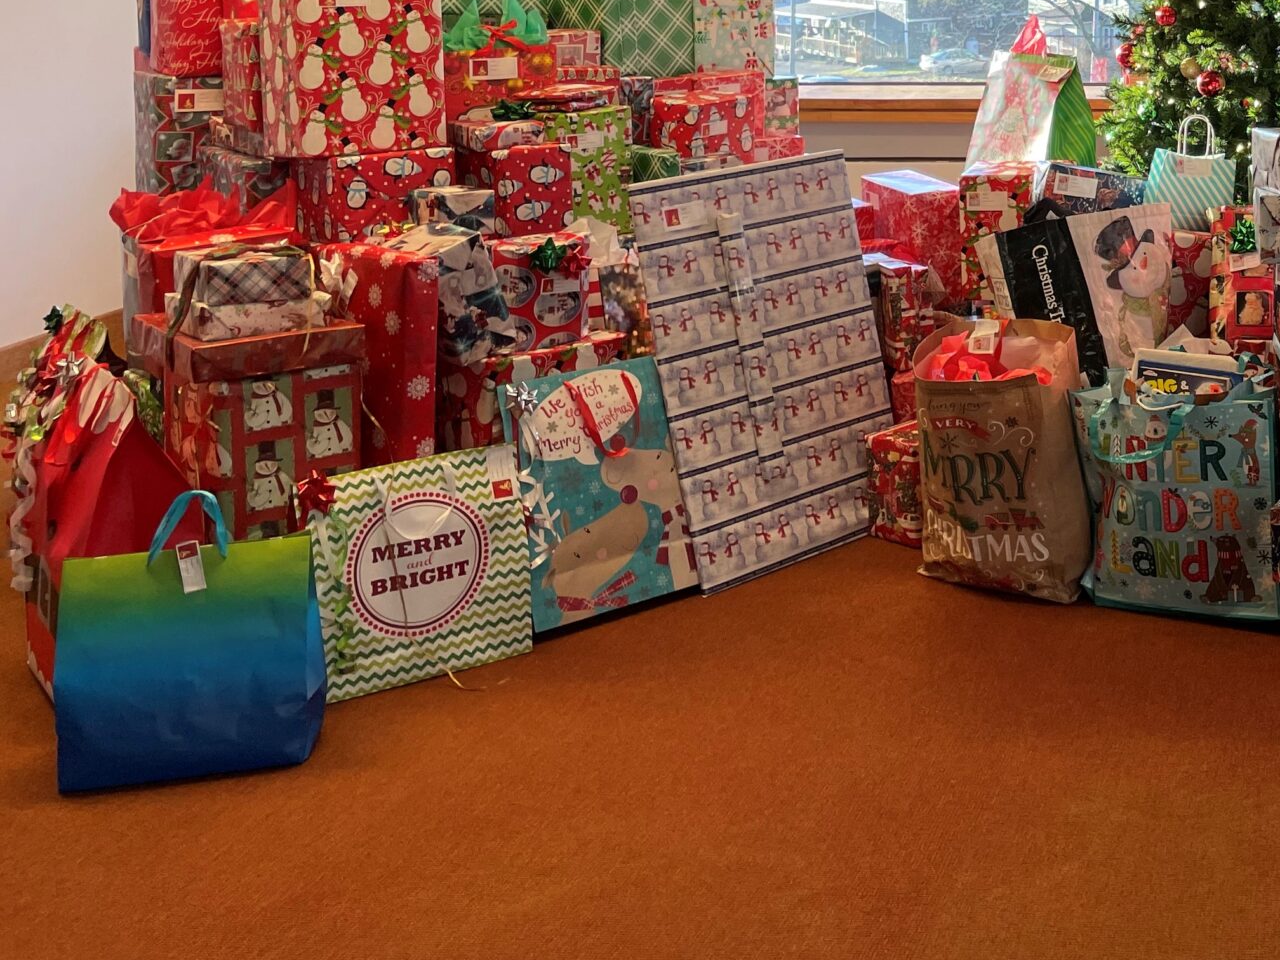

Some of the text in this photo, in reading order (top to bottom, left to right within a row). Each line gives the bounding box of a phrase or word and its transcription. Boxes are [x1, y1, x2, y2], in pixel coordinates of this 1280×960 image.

[1031, 244, 1058, 311] Christmas
[1181, 380, 1190, 390] &
[540, 398, 567, 419] We
[595, 400, 605, 410] a
[541, 401, 634, 455] Merry Cristmas
[935, 418, 978, 430] VERY
[921, 428, 1037, 507] MRRY
[371, 529, 466, 563] MERRY
[406, 551, 434, 570] and
[370, 559, 470, 597] BRIGHT
